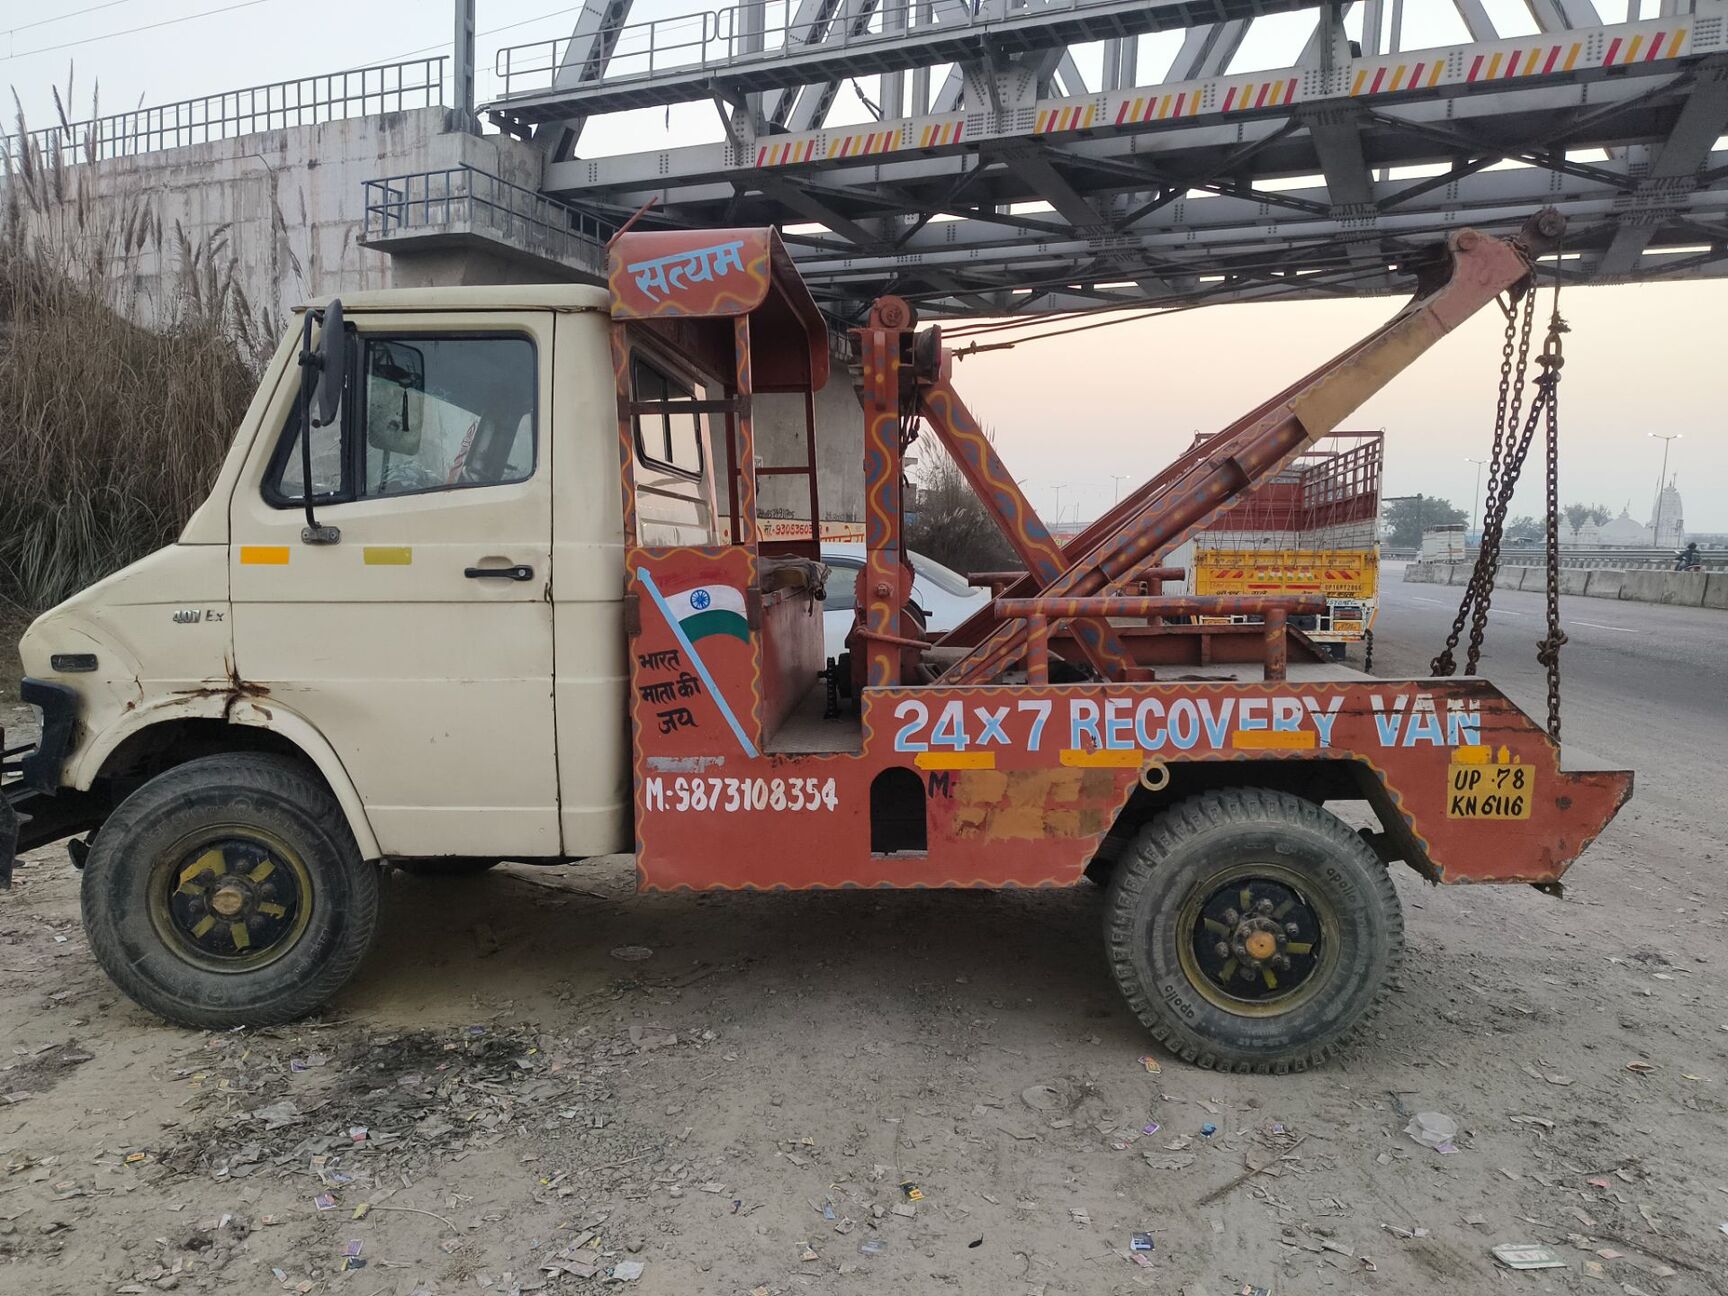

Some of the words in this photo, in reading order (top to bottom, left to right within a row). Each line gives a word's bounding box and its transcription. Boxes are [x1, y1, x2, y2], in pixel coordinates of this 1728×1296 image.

[627, 240, 745, 303] सत्यम
[172, 609, 201, 624] 407
[638, 649, 681, 671] भारत
[638, 681, 677, 704] माता
[676, 671, 702, 698] की
[656, 707, 699, 735] जय
[1070, 696, 1345, 750] RECOVERY
[1370, 693, 1481, 747] VAN
[1454, 769, 1481, 791] UP
[1326, 867, 1357, 903] apollo
[1164, 984, 1195, 1019] apollo
